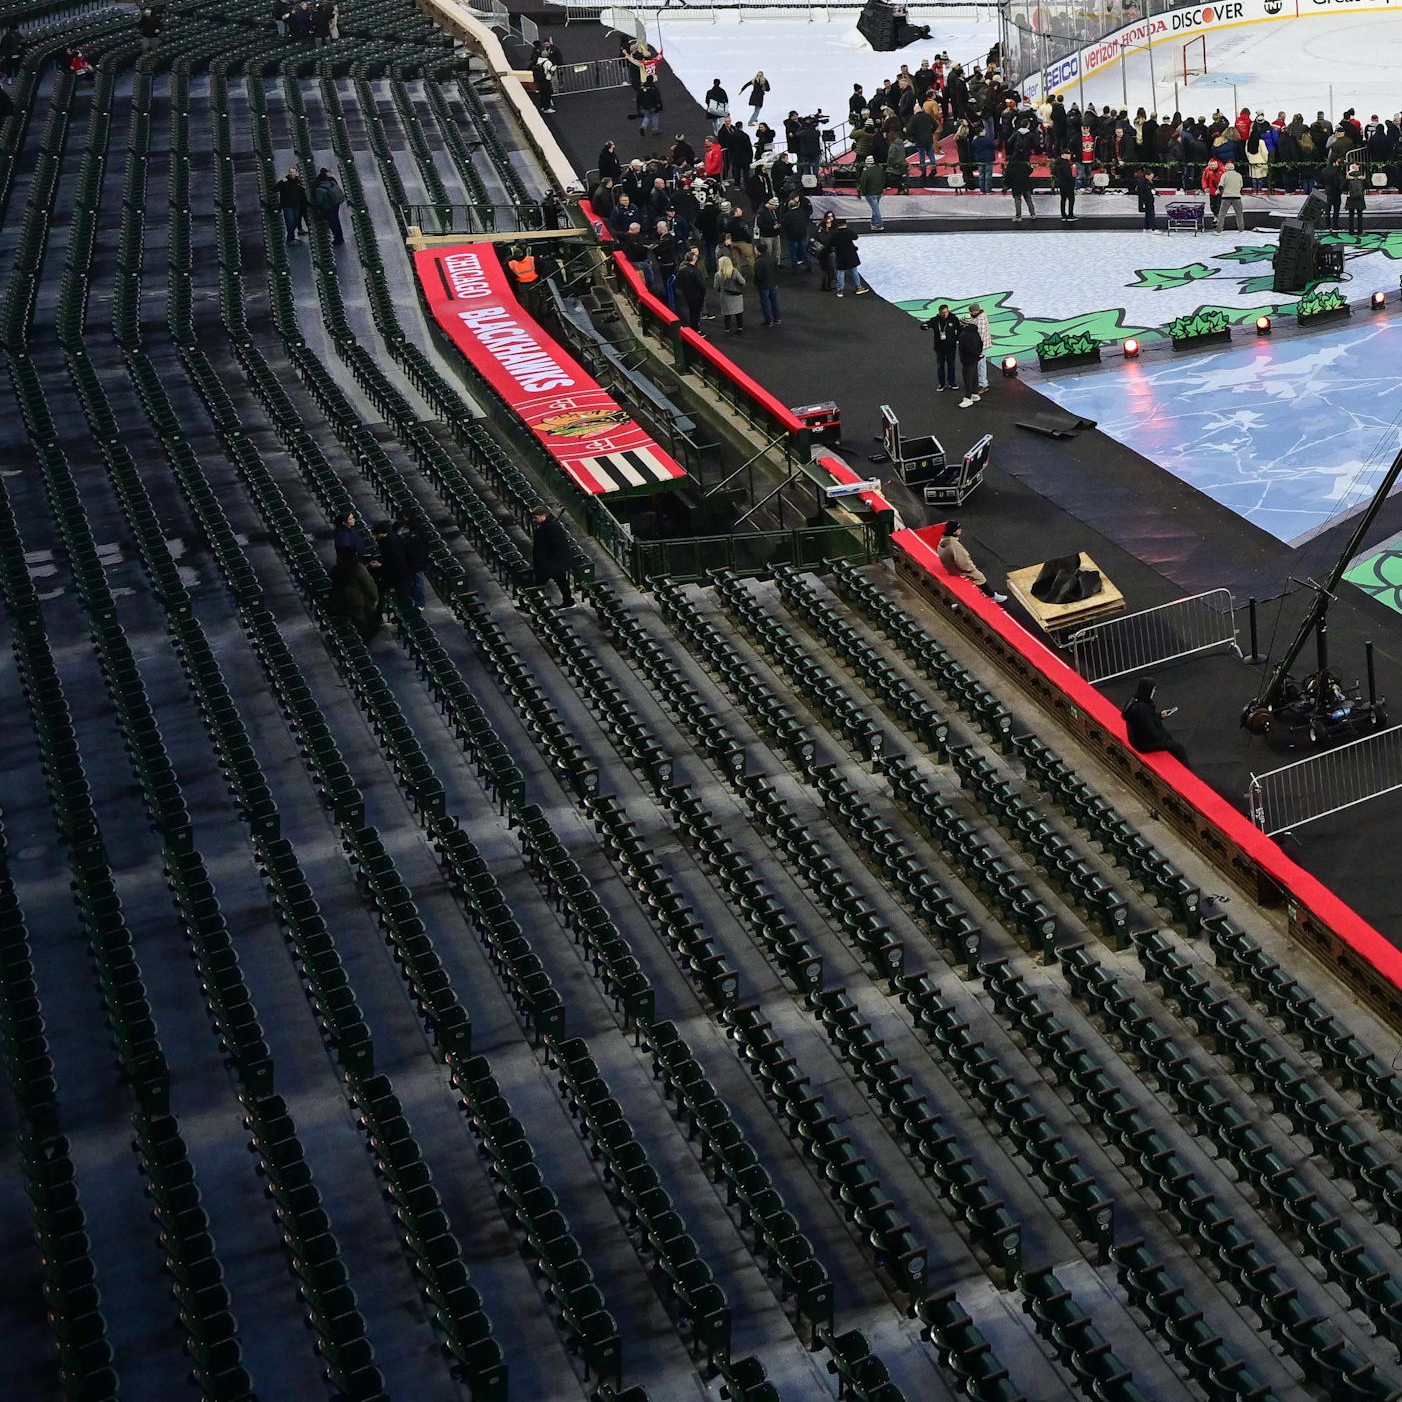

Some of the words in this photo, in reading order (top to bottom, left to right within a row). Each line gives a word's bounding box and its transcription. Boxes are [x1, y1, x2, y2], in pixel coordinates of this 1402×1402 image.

[1121, 19, 1168, 47] HONDA
[1172, 3, 1244, 31] DISCOVER
[1085, 39, 1119, 71] verizon
[444, 253, 493, 298] CHICAGO
[457, 306, 575, 393] BLACKHAWKS
